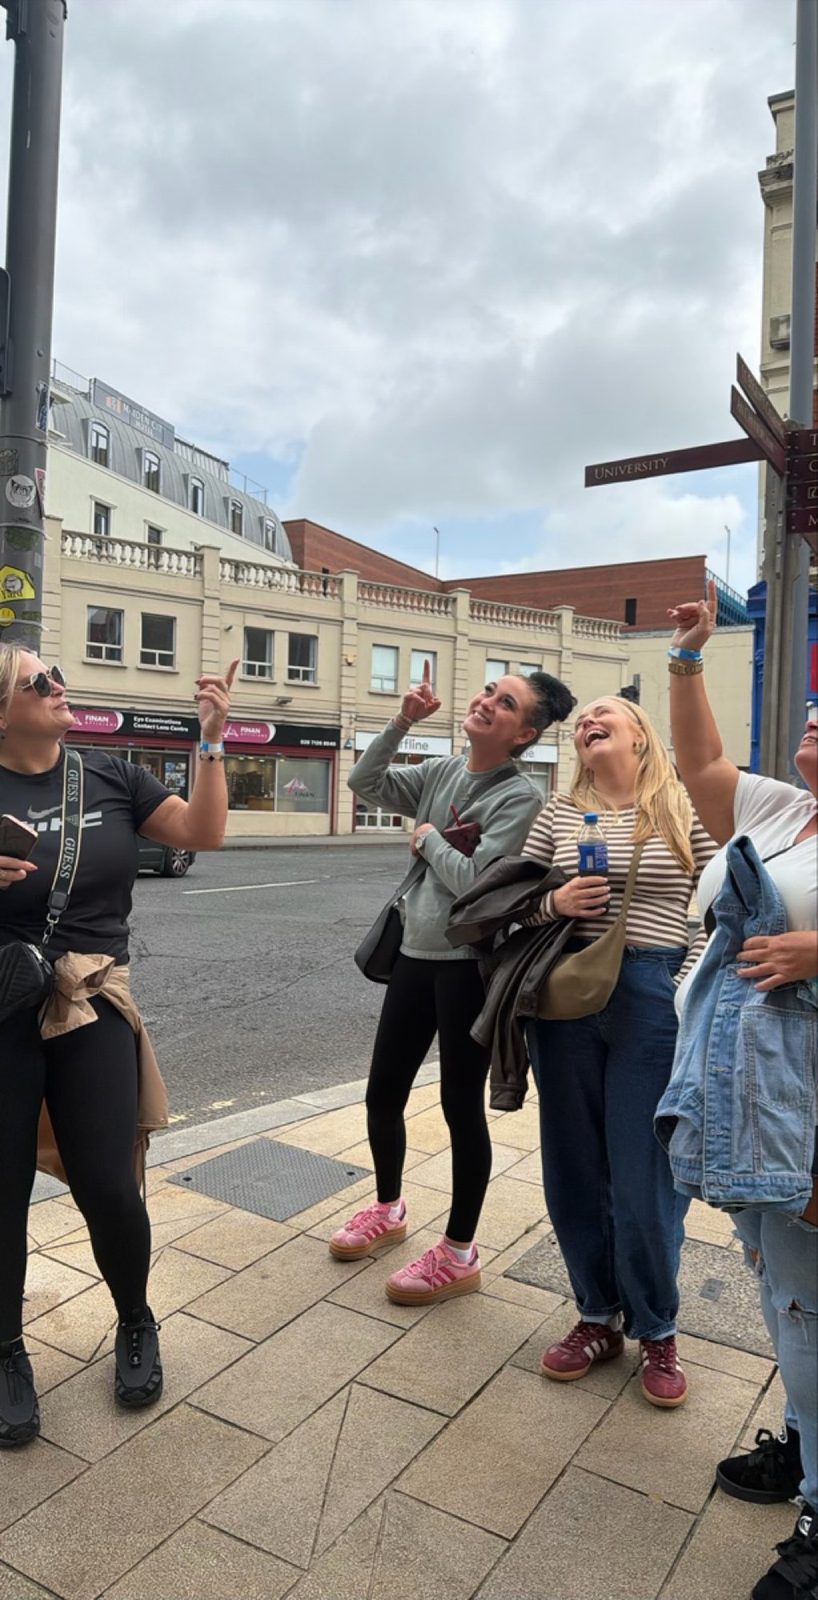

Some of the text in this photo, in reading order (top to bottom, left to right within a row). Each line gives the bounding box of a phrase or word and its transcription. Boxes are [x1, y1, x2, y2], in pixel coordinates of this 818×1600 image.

[594, 458, 669, 480] UNIVERSITY
[85, 714, 109, 722] FINAN
[133, 715, 182, 725] Eye Examinations
[240, 726, 261, 734] FINAN
[67, 769, 79, 802] GUESS
[59, 837, 76, 879] GUESS
